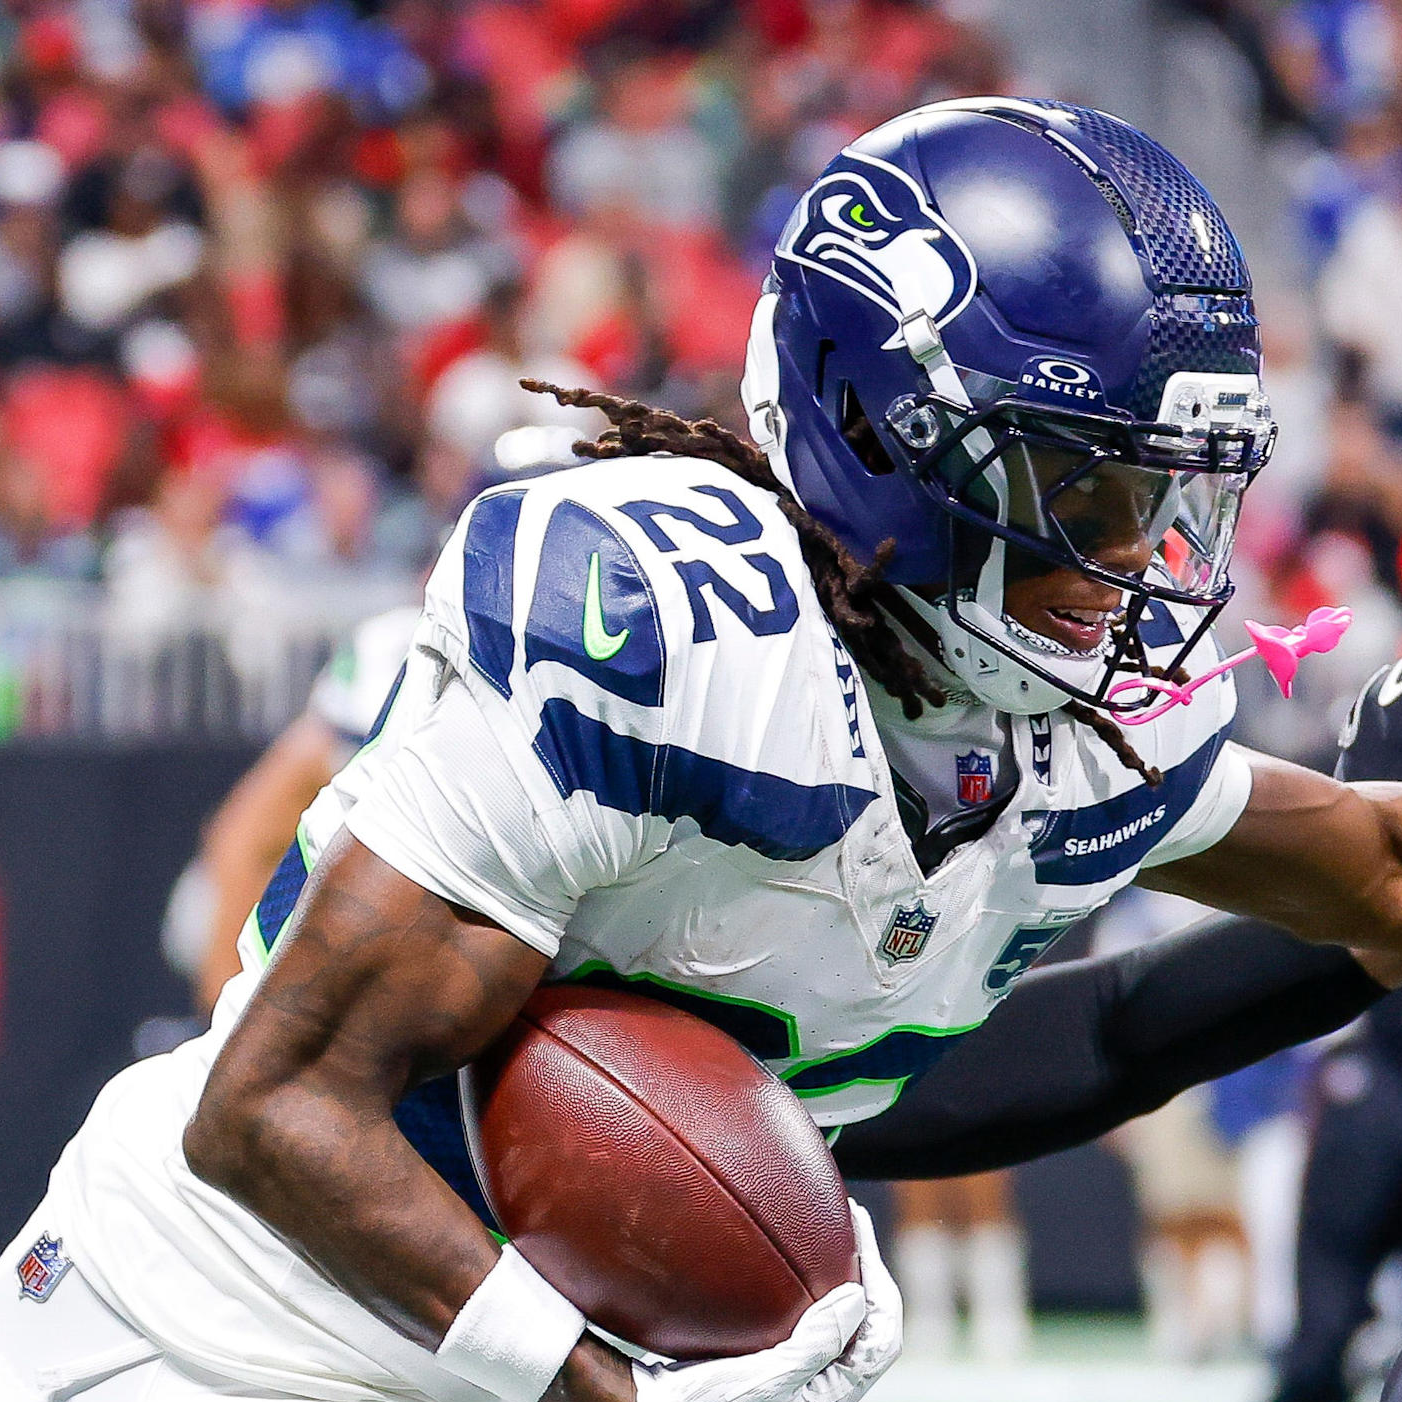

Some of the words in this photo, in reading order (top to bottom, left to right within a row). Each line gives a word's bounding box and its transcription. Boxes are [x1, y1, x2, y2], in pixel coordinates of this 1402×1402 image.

[1022, 374, 1102, 400] OAKLEY
[612, 484, 800, 644] 22
[1064, 803, 1167, 857] SEAHAWKS
[887, 930, 922, 957] NFL
[20, 1254, 48, 1292] NFL
